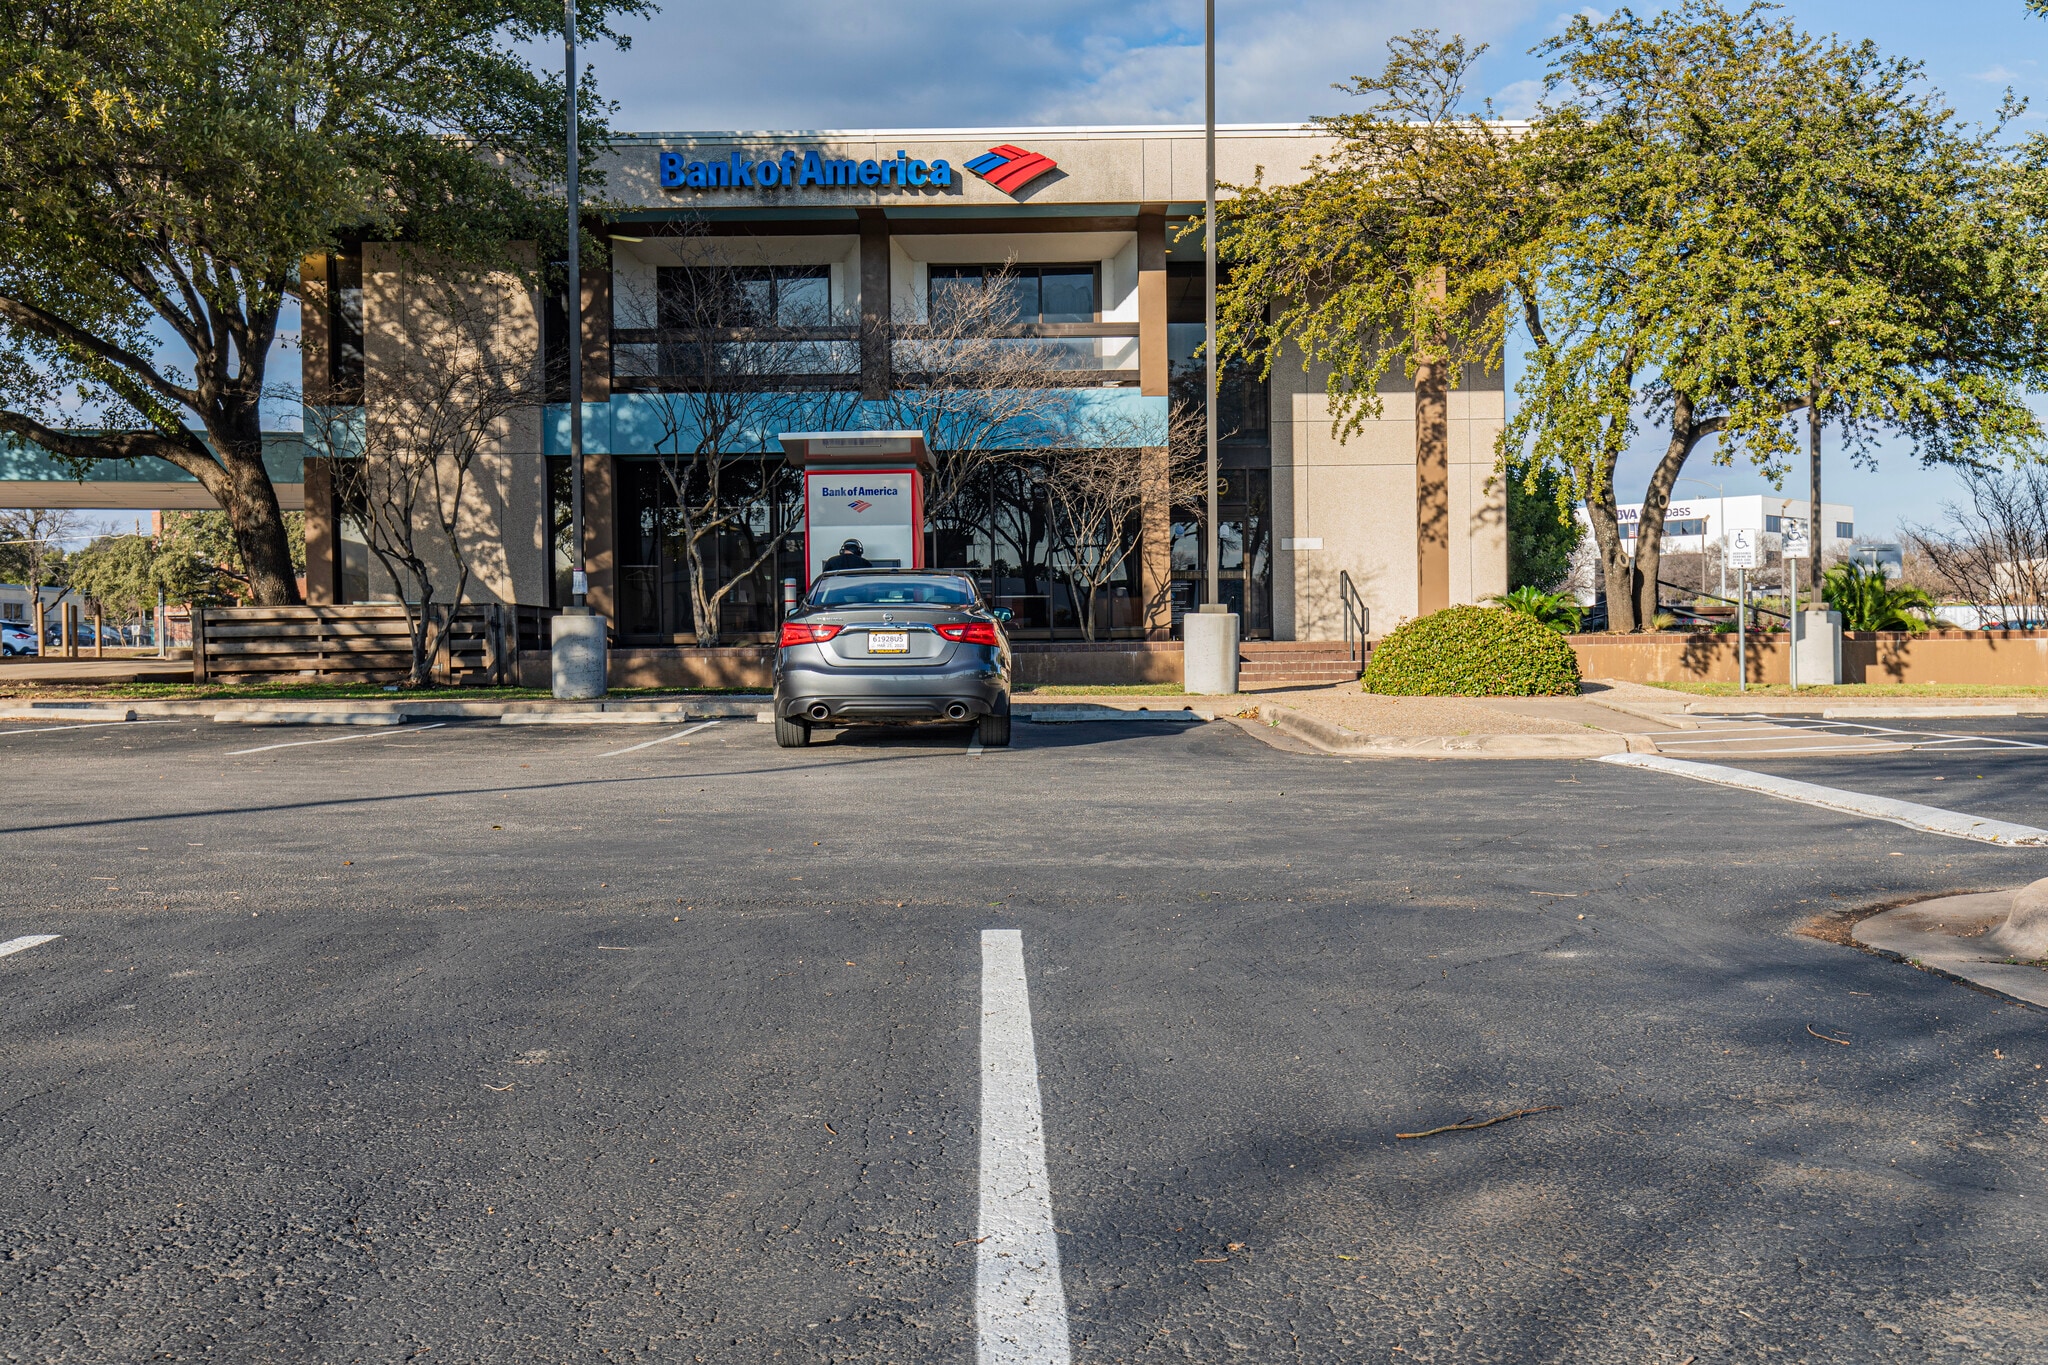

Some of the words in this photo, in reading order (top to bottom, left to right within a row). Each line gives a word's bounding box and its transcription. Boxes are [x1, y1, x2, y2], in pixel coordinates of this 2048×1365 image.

[660, 151, 754, 188] Bank
[755, 150, 796, 188] of
[799, 149, 952, 188] America
[822, 487, 847, 497] Bank
[847, 486, 858, 496] of
[858, 486, 898, 496] America
[1616, 508, 1638, 520] BVA
